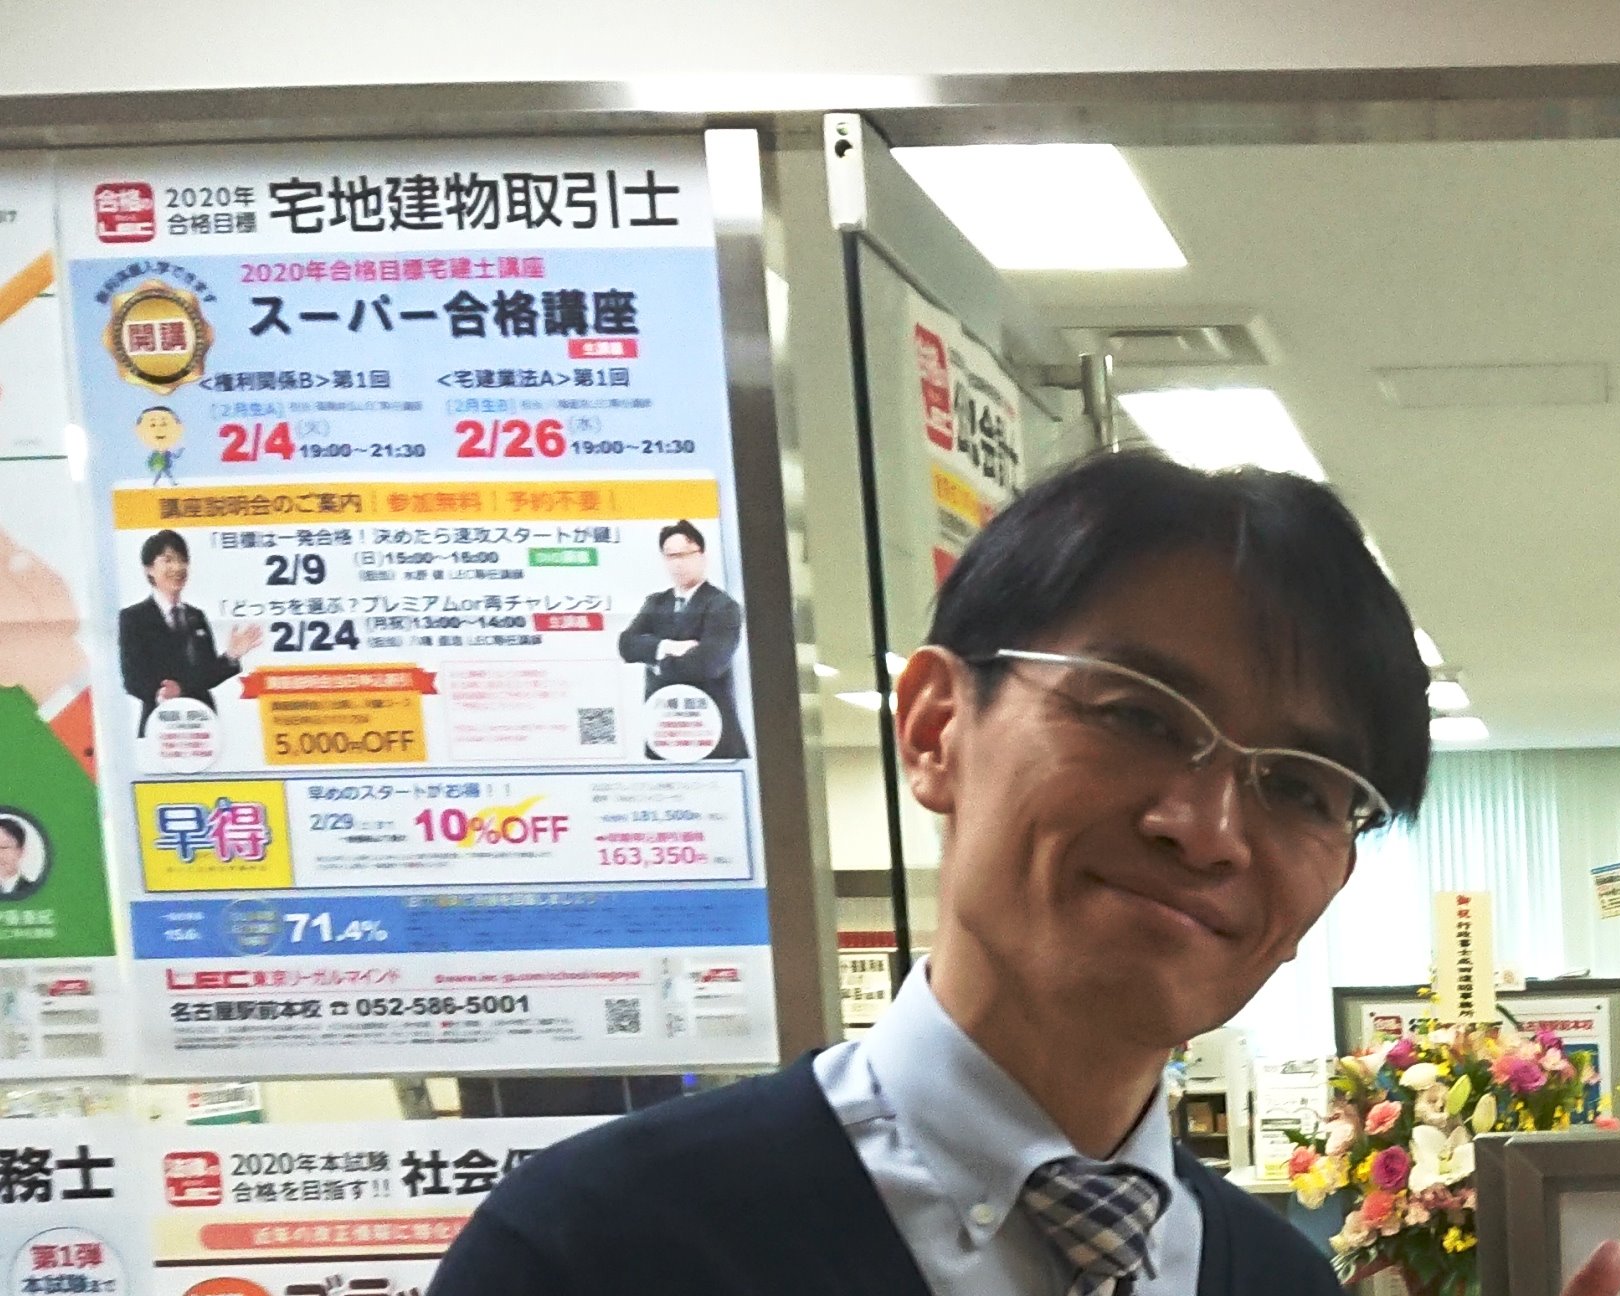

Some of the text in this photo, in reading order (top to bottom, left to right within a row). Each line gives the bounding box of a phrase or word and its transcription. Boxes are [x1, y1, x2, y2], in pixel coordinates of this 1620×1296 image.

[165, 186, 255, 208] 2020年
[269, 168, 681, 235] 宅地建物取引士
[167, 211, 257, 236] 合格目標
[249, 287, 640, 338] スーパー合格講座
[218, 421, 296, 462] 2/4
[455, 418, 567, 458] 2/26
[265, 553, 326, 586] 2/9
[270, 619, 361, 652] 2/24
[309, 812, 355, 832] 2/29
[413, 807, 570, 845] 10%OFF
[282, 911, 389, 944] 71.4%
[355, 994, 531, 1018] 052-586-5001
[0, 1145, 115, 1204] 務士
